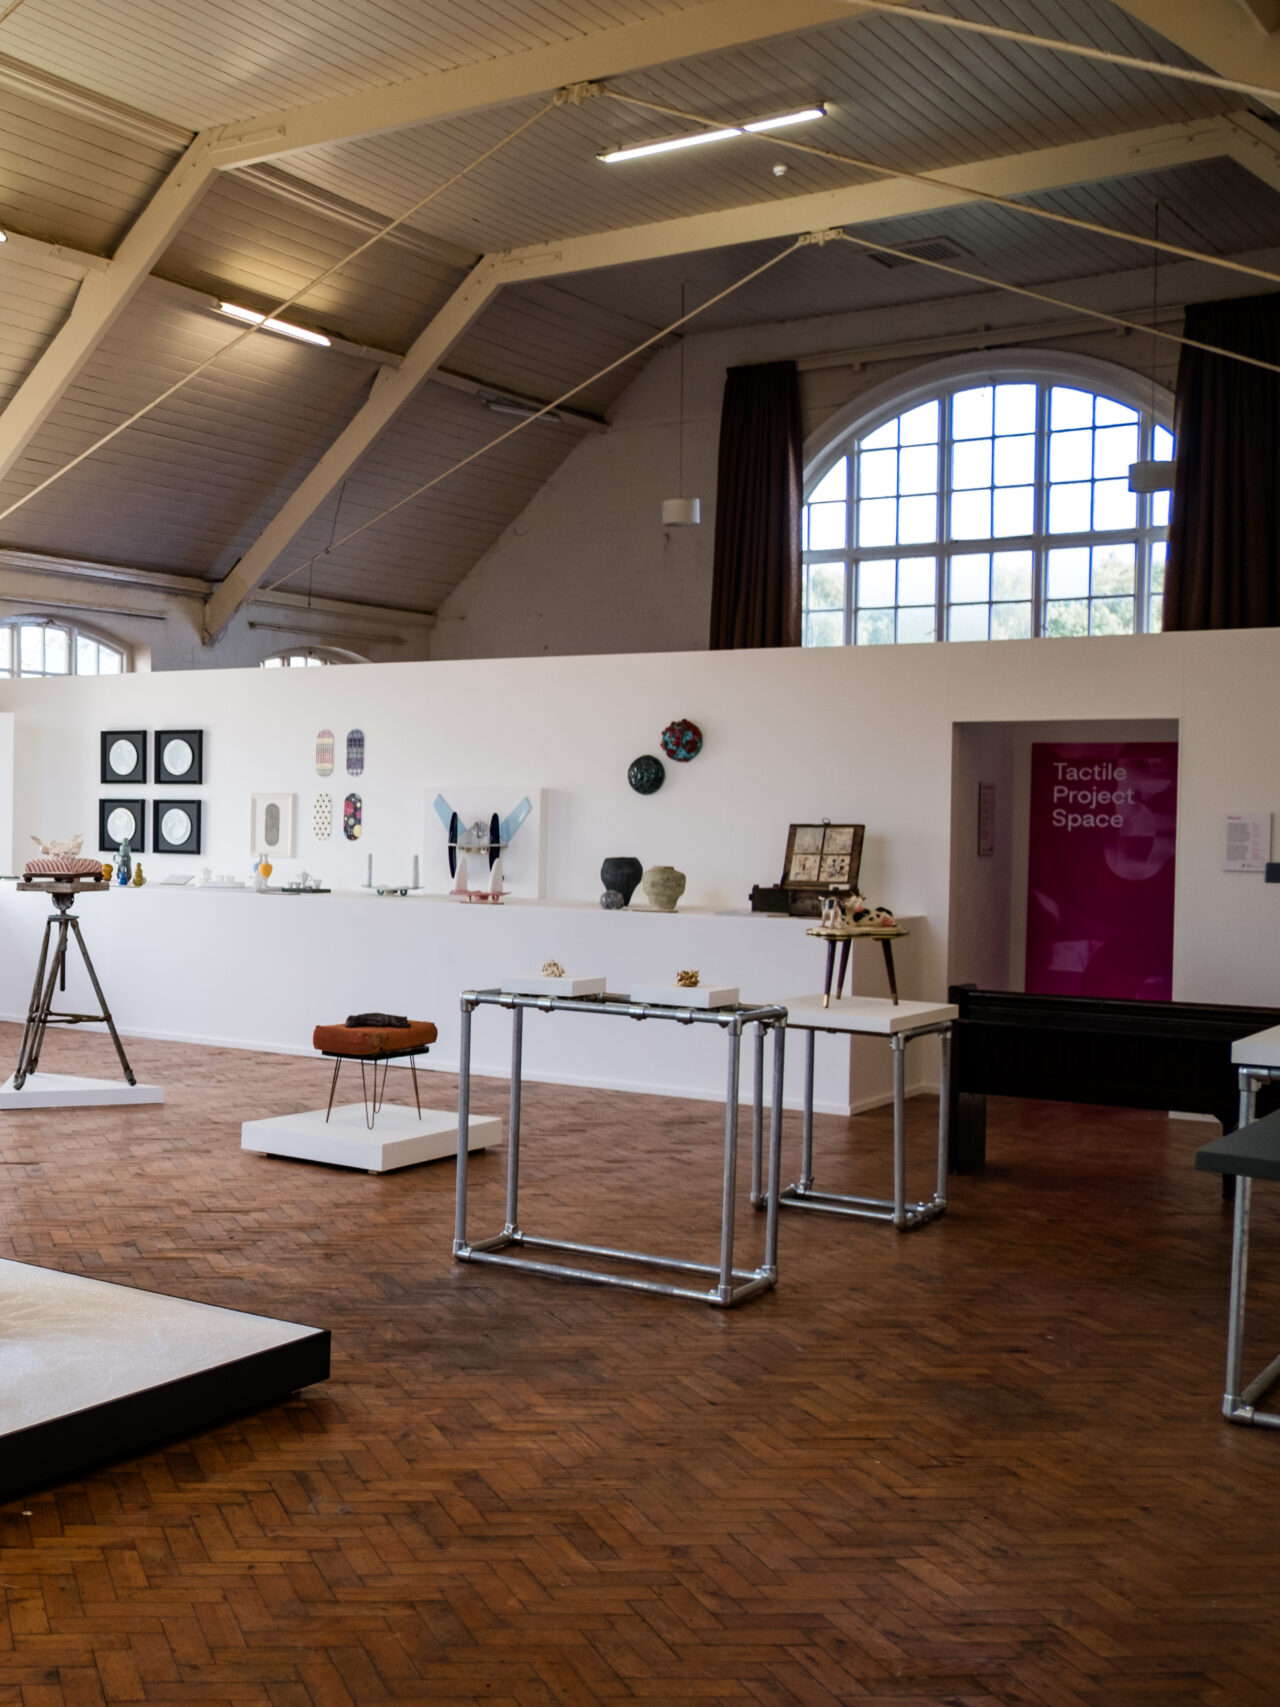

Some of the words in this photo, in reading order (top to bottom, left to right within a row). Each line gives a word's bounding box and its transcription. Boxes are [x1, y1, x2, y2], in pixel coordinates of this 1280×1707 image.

[1053, 762, 1127, 781] Tactile
[1053, 785, 1135, 809] Project
[1052, 808, 1124, 832] Space
